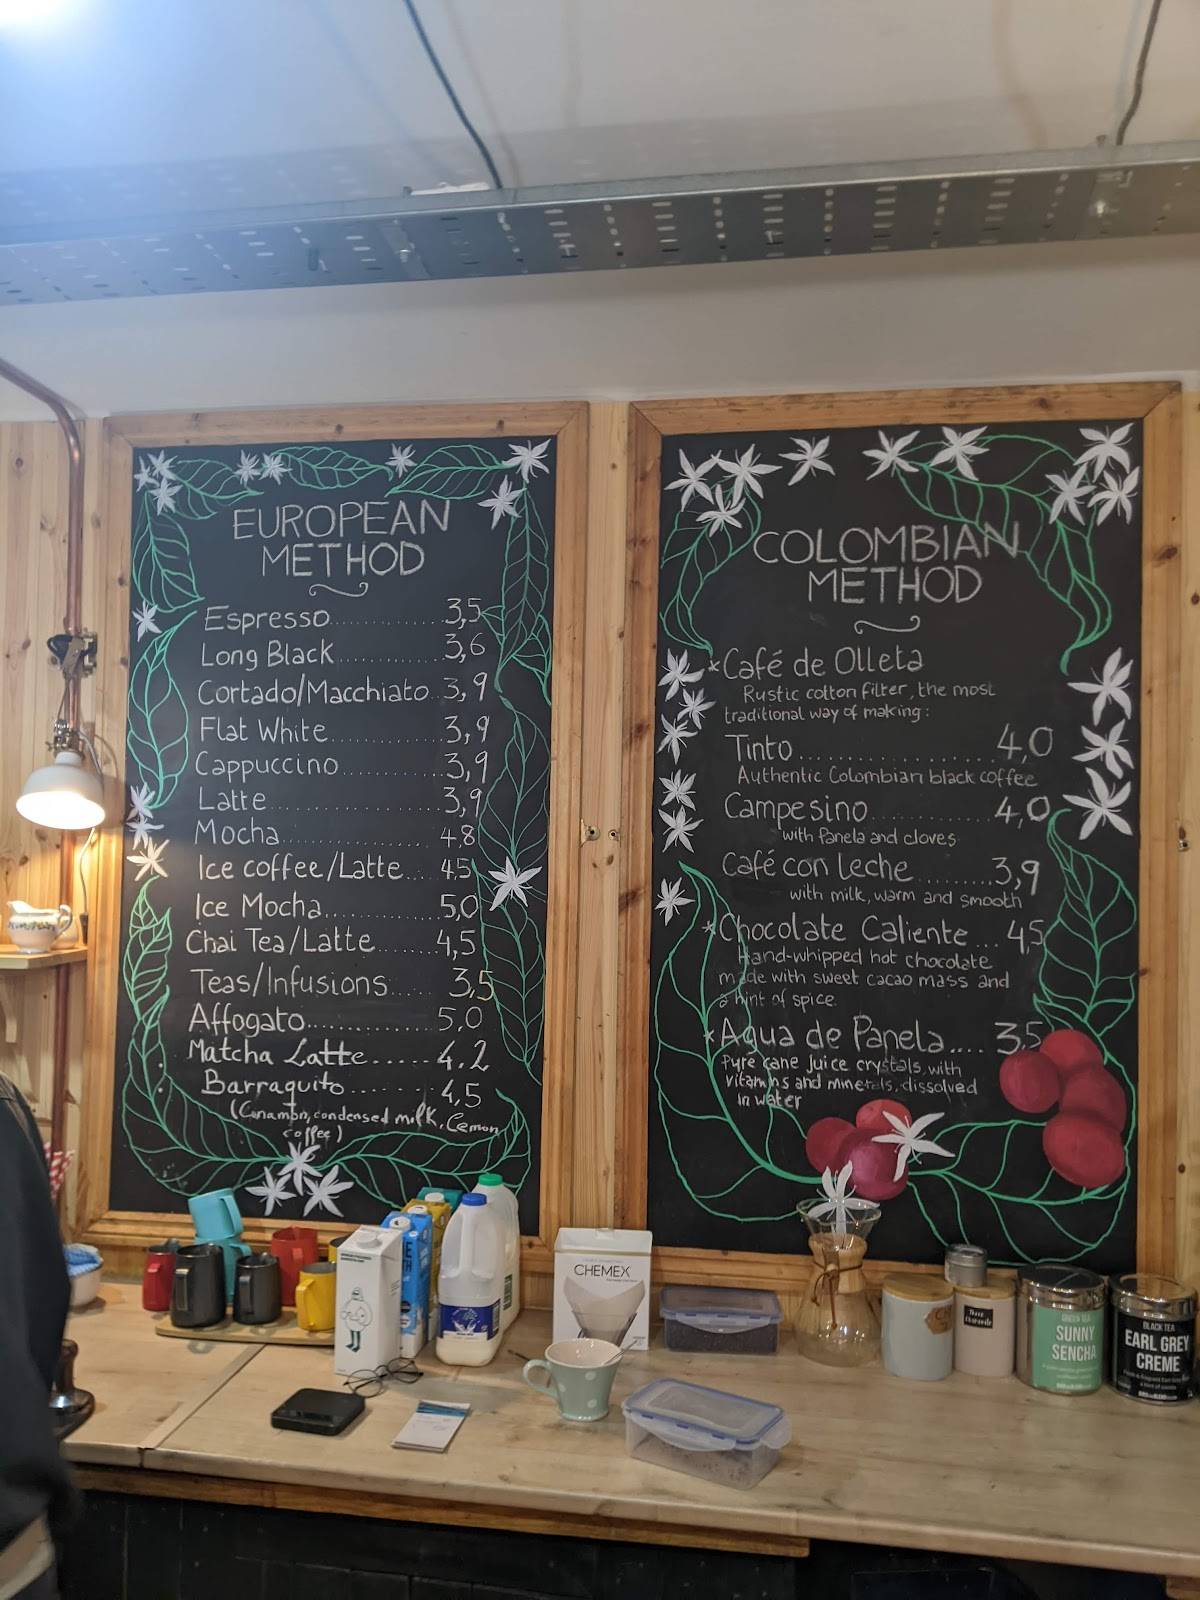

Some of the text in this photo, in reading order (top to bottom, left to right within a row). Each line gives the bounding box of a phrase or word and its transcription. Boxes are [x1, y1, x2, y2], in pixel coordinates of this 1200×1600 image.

[233, 499, 451, 539] EUROPEAN
[753, 521, 1019, 564] COLOMBIAN
[262, 541, 425, 577] METHOD
[808, 565, 983, 605] METHOD
[204, 597, 482, 635] Espresso 3,5
[201, 632, 486, 672] Long Black 3,6
[722, 644, 923, 680] Café de Olleta
[197, 671, 488, 707] Cortado/Macchiato 3,9
[743, 684, 799, 703] Rustic
[806, 686, 856, 701] cotton
[918, 682, 946, 697] the
[953, 683, 996, 697] most
[200, 715, 490, 745] Flat White 3,9
[724, 707, 805, 724] traditional
[809, 708, 838, 723] way
[843, 705, 859, 722] of
[725, 723, 1054, 764] Tinto 4,0
[195, 750, 489, 784] Cappuccino 3,9
[737, 765, 1038, 788] Authentic Colombian black coffee
[199, 786, 483, 818] Latte 3,9
[724, 791, 1051, 830] Campesino 4,0
[194, 816, 476, 849] Mocha 4,8
[782, 827, 814, 842] with
[818, 828, 866, 845] Panela
[870, 829, 897, 845] and
[198, 853, 234, 881] Ice
[721, 849, 776, 880] Café
[782, 856, 829, 879] con
[991, 856, 1041, 896] 3,9
[195, 890, 479, 922] Ice Mocha 5,0
[789, 884, 823, 902] with
[874, 889, 916, 903] warm
[923, 890, 953, 906] and
[960, 893, 1022, 909] smooth
[186, 925, 476, 961] Chai Tea/Latte 4,5
[719, 911, 1045, 955] Chocolate Caliente 4,5
[737, 944, 994, 971] Hand-whipped hot chocolate
[190, 962, 494, 1001] Teas/Infusions 3,5
[771, 969, 806, 985] with
[813, 969, 860, 986] sweet
[866, 972, 913, 987] cacao
[918, 973, 969, 989] mass
[977, 971, 1010, 990] and
[735, 989, 765, 1007] hint
[772, 987, 787, 1009] of
[188, 1001, 483, 1038] Affogato 5,0
[721, 1014, 1044, 1055] Agua de Panela 3,5
[187, 1037, 274, 1065] Matcha
[283, 1037, 369, 1068] Latte
[762, 1056, 799, 1070] cane
[927, 1061, 962, 1077] with
[200, 1068, 482, 1112] Barraquito 4,5
[794, 1074, 821, 1089] and
[902, 1079, 978, 1096] dissolved
[314, 1106, 389, 1124] condensed
[755, 1093, 802, 1110] water
[283, 1124, 342, 1145] coffee)
[574, 1264, 631, 1278] CHEMEX
[1056, 1325, 1095, 1342] SUNNY
[1125, 1328, 1189, 1352] EARL GREY
[1143, 1321, 1175, 1333] BLACK TEA
[1052, 1344, 1096, 1361] SENCHA
[1136, 1352, 1180, 1372] CREME
